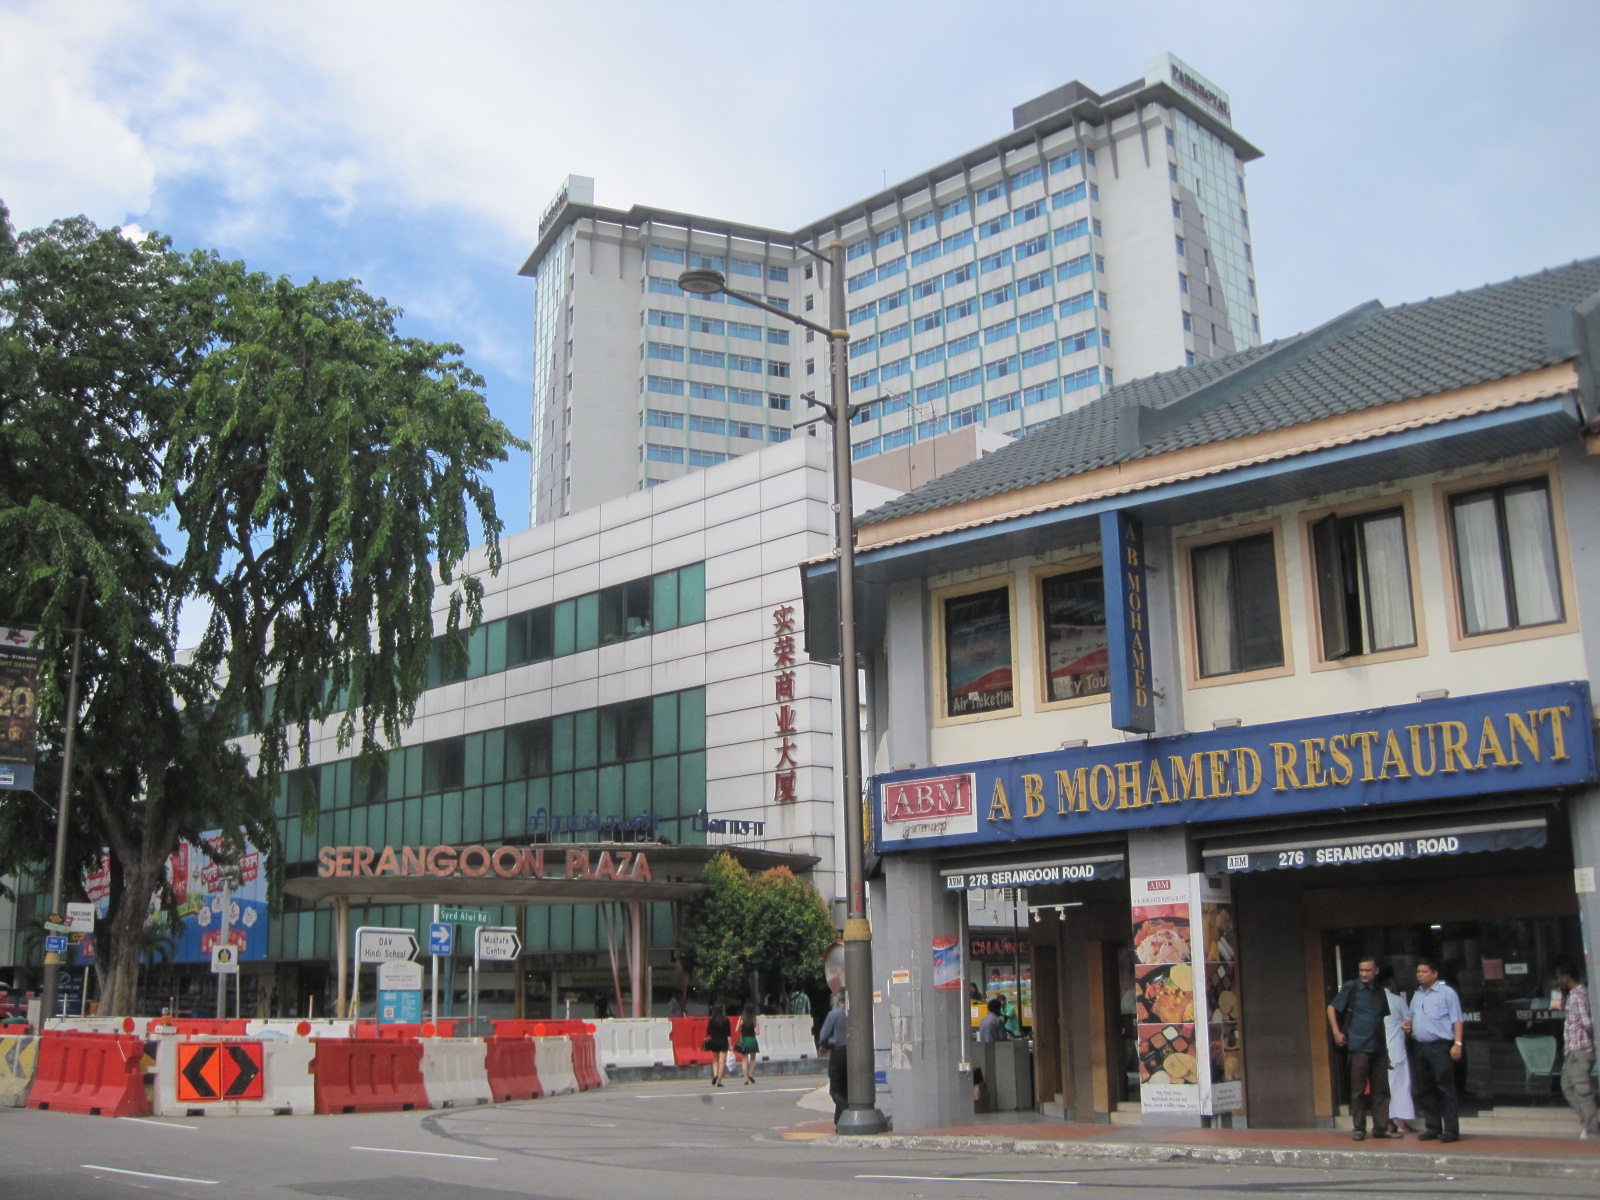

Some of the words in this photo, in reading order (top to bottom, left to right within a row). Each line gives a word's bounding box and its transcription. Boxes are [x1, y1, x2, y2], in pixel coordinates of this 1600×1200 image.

[1126, 524, 1135, 541] A
[1127, 547, 1138, 566] B
[1128, 572, 1148, 707] MOHAMED
[14, 662, 37, 670] SAFARI
[1086, 673, 1111, 691] Tou
[773, 605, 797, 802] 实荣商业大厦
[953, 697, 968, 712] Air
[987, 778, 1013, 820] A
[1021, 774, 1045, 817] B
[1055, 747, 1262, 814] MOHAMED
[1270, 706, 1571, 790] RESTAURANT
[891, 783, 966, 817] ABM
[903, 820, 948, 840] group
[1229, 857, 1249, 869] ABM
[1279, 851, 1304, 866] 276
[1316, 842, 1404, 863] SERANGOON
[1417, 836, 1458, 854] ROAD
[318, 845, 544, 879] SERANGOON
[565, 850, 652, 882] PLAZA
[969, 873, 989, 887] 278
[991, 867, 1059, 884] SERANGOON
[1063, 864, 1094, 879] ROAD
[1149, 880, 1169, 890] ABM
[441, 910, 458, 922] Syed
[460, 912, 476, 922] Alwi
[478, 913, 487, 922] Rd
[379, 937, 393, 946] DAV
[484, 935, 509, 945] Mustafa
[365, 949, 382, 957] Hindi
[385, 949, 406, 958] School
[486, 946, 507, 956] Centre
